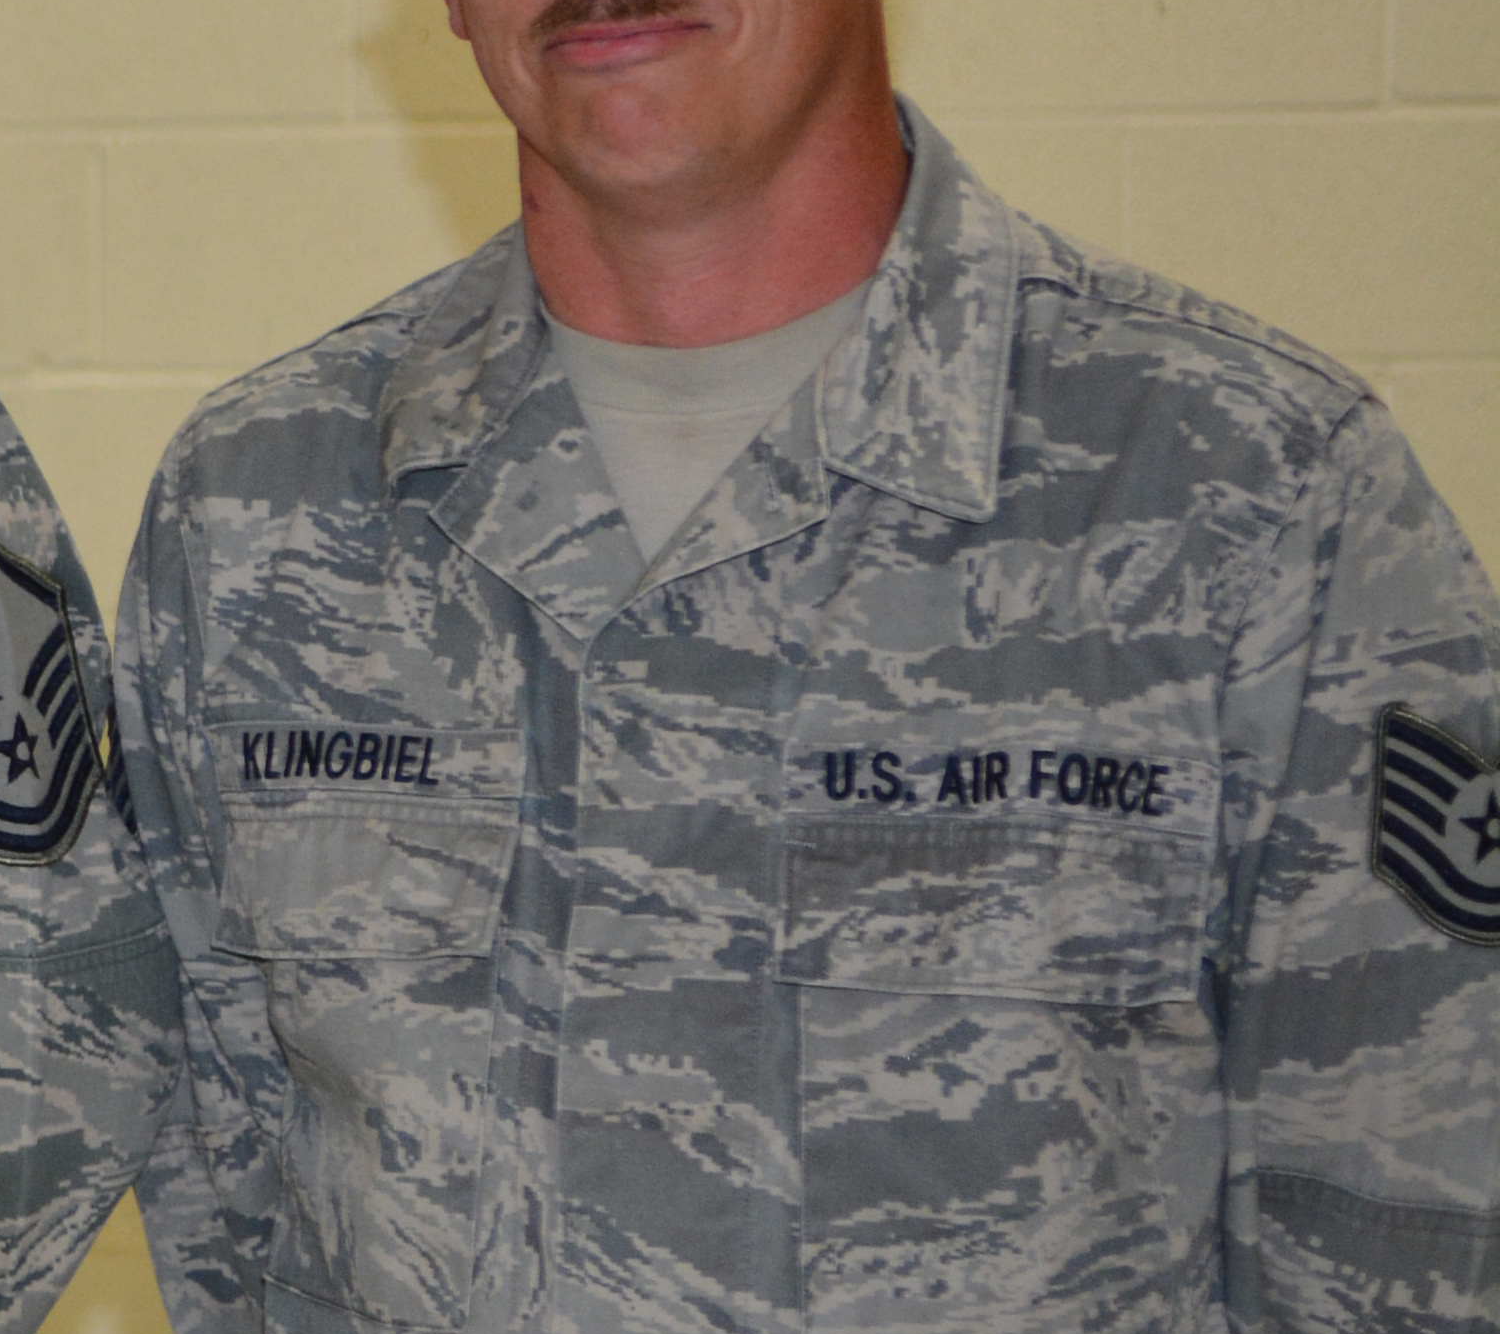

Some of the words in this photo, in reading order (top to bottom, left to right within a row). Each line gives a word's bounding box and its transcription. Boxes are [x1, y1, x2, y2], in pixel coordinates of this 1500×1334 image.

[242, 730, 440, 786] KLINGBIEL
[825, 751, 917, 802] U.S.
[937, 751, 1010, 805] AIR
[1029, 750, 1172, 816] FORCE
